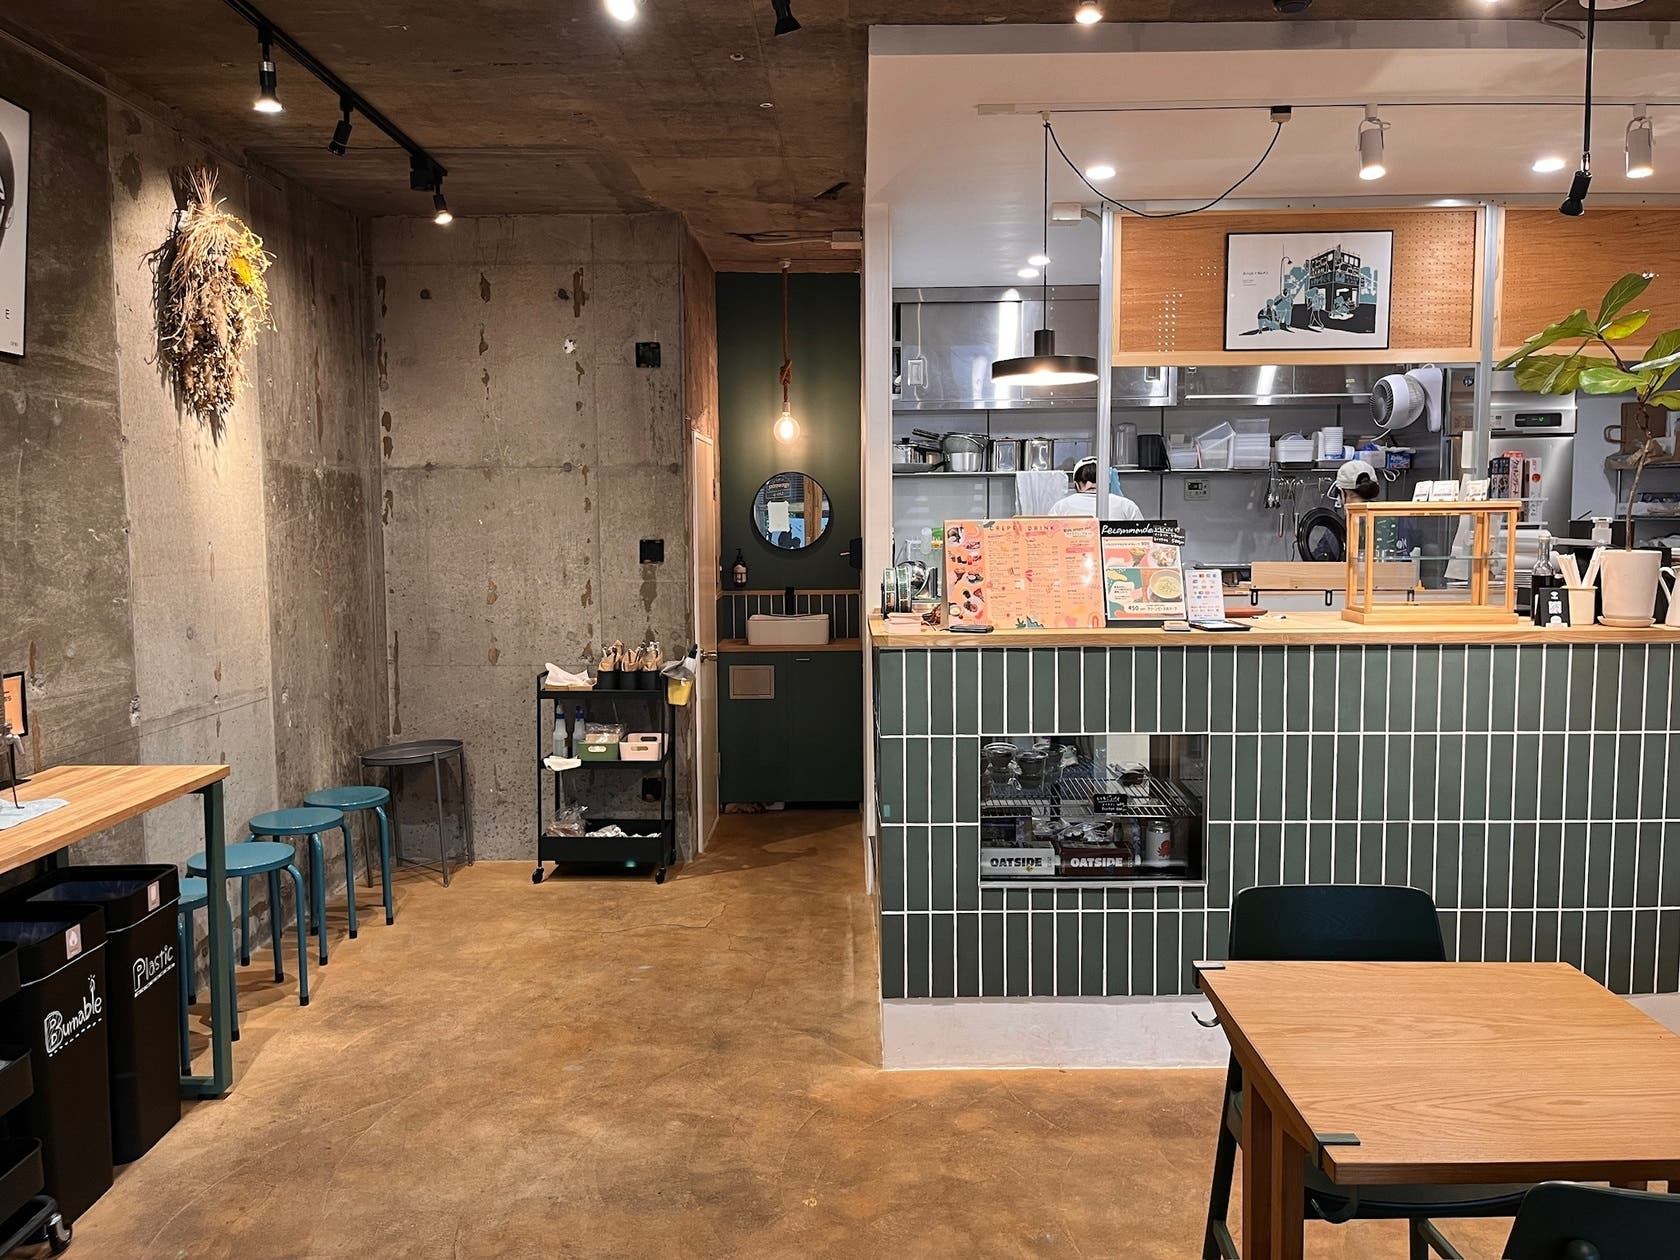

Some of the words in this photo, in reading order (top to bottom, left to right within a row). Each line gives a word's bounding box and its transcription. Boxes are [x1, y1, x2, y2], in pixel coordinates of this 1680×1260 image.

[990, 857, 1043, 867] OATSIDE
[1070, 857, 1123, 868] OATSIDE
[132, 944, 174, 992] Plastic
[44, 975, 102, 1054] Burnable
